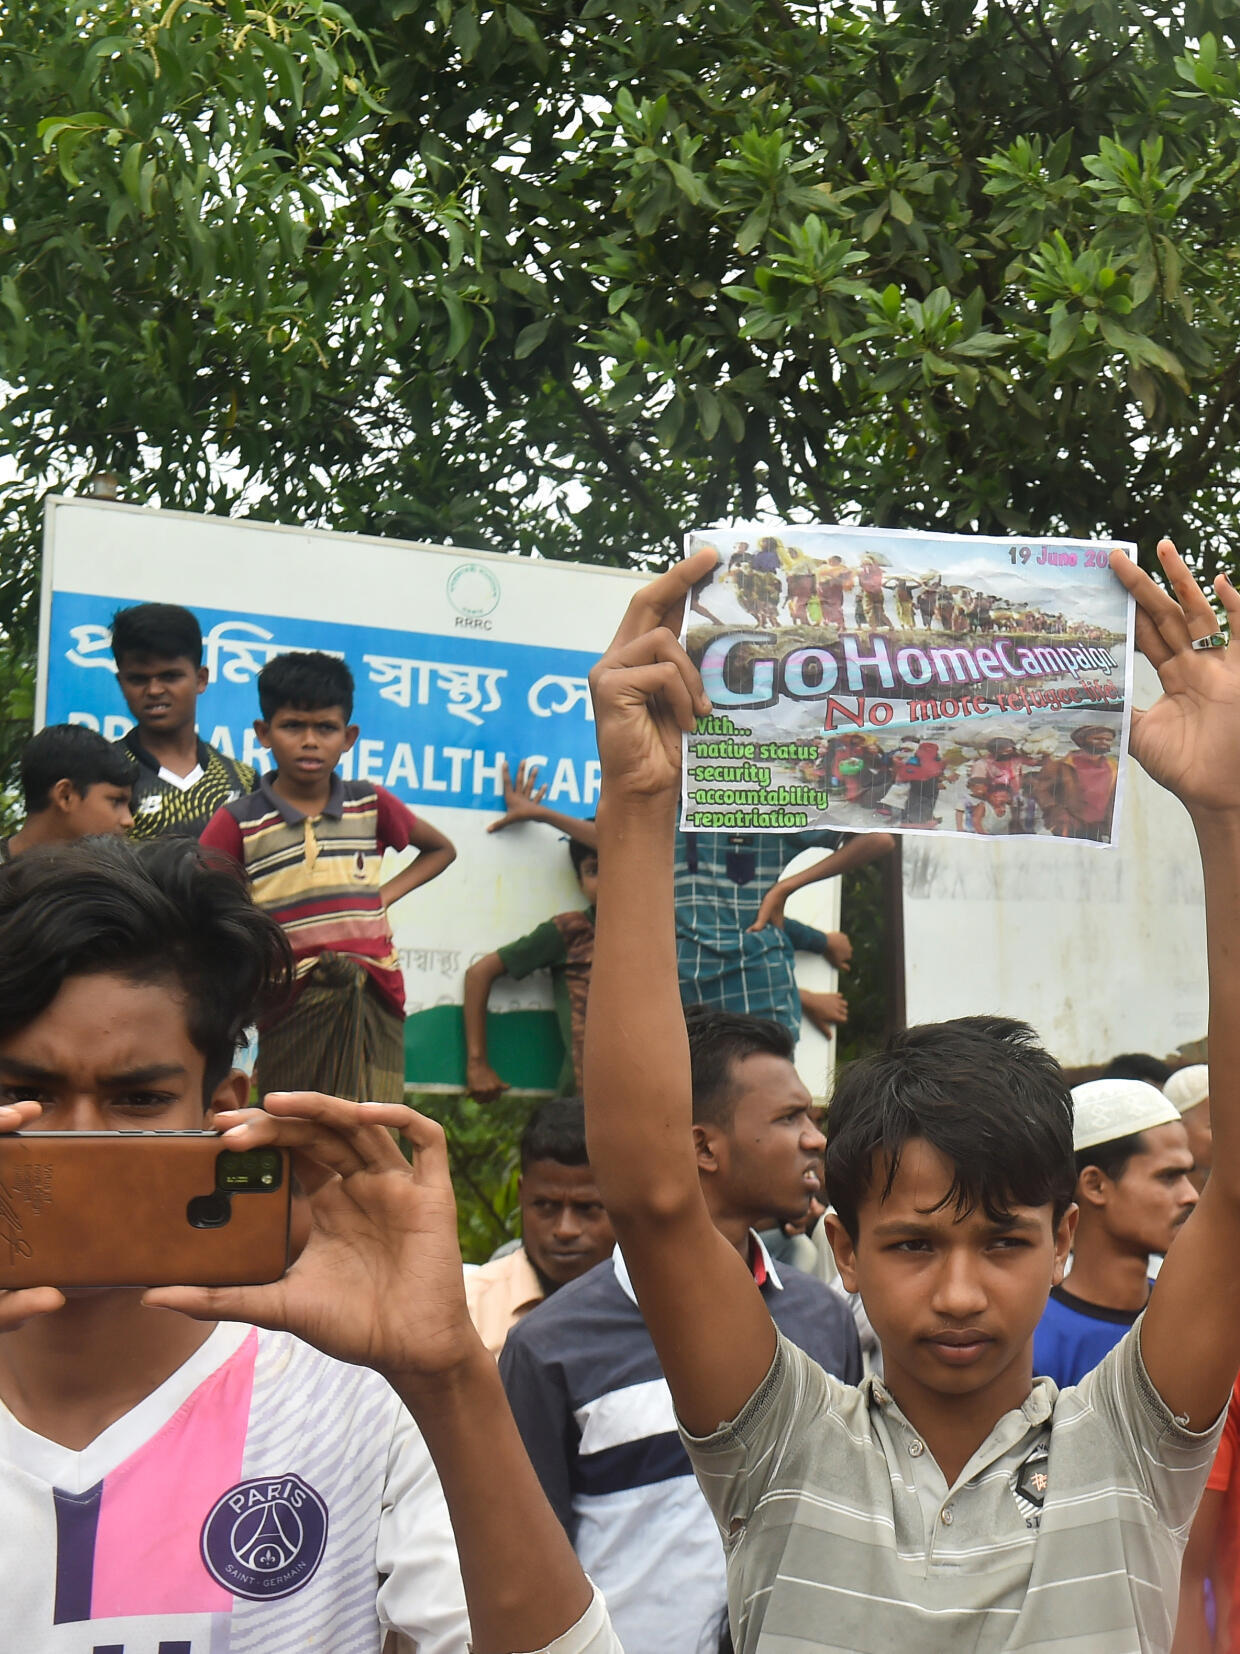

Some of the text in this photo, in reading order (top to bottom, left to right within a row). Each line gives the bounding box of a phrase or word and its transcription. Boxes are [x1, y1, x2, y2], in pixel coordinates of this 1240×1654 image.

[1009, 545, 1113, 569] 19 June 20
[455, 616, 493, 631] RRRC
[362, 654, 508, 726] স্বাস্থ্য
[824, 696, 894, 731] No
[907, 695, 989, 723] more
[996, 685, 1081, 715] refugee
[759, 742, 818, 760] status
[523, 754, 602, 804] CAR
[687, 761, 771, 787] -security
[687, 786, 828, 810] -accountability
[686, 807, 808, 828] -repatriation
[228, 1482, 307, 1514] PARIS
